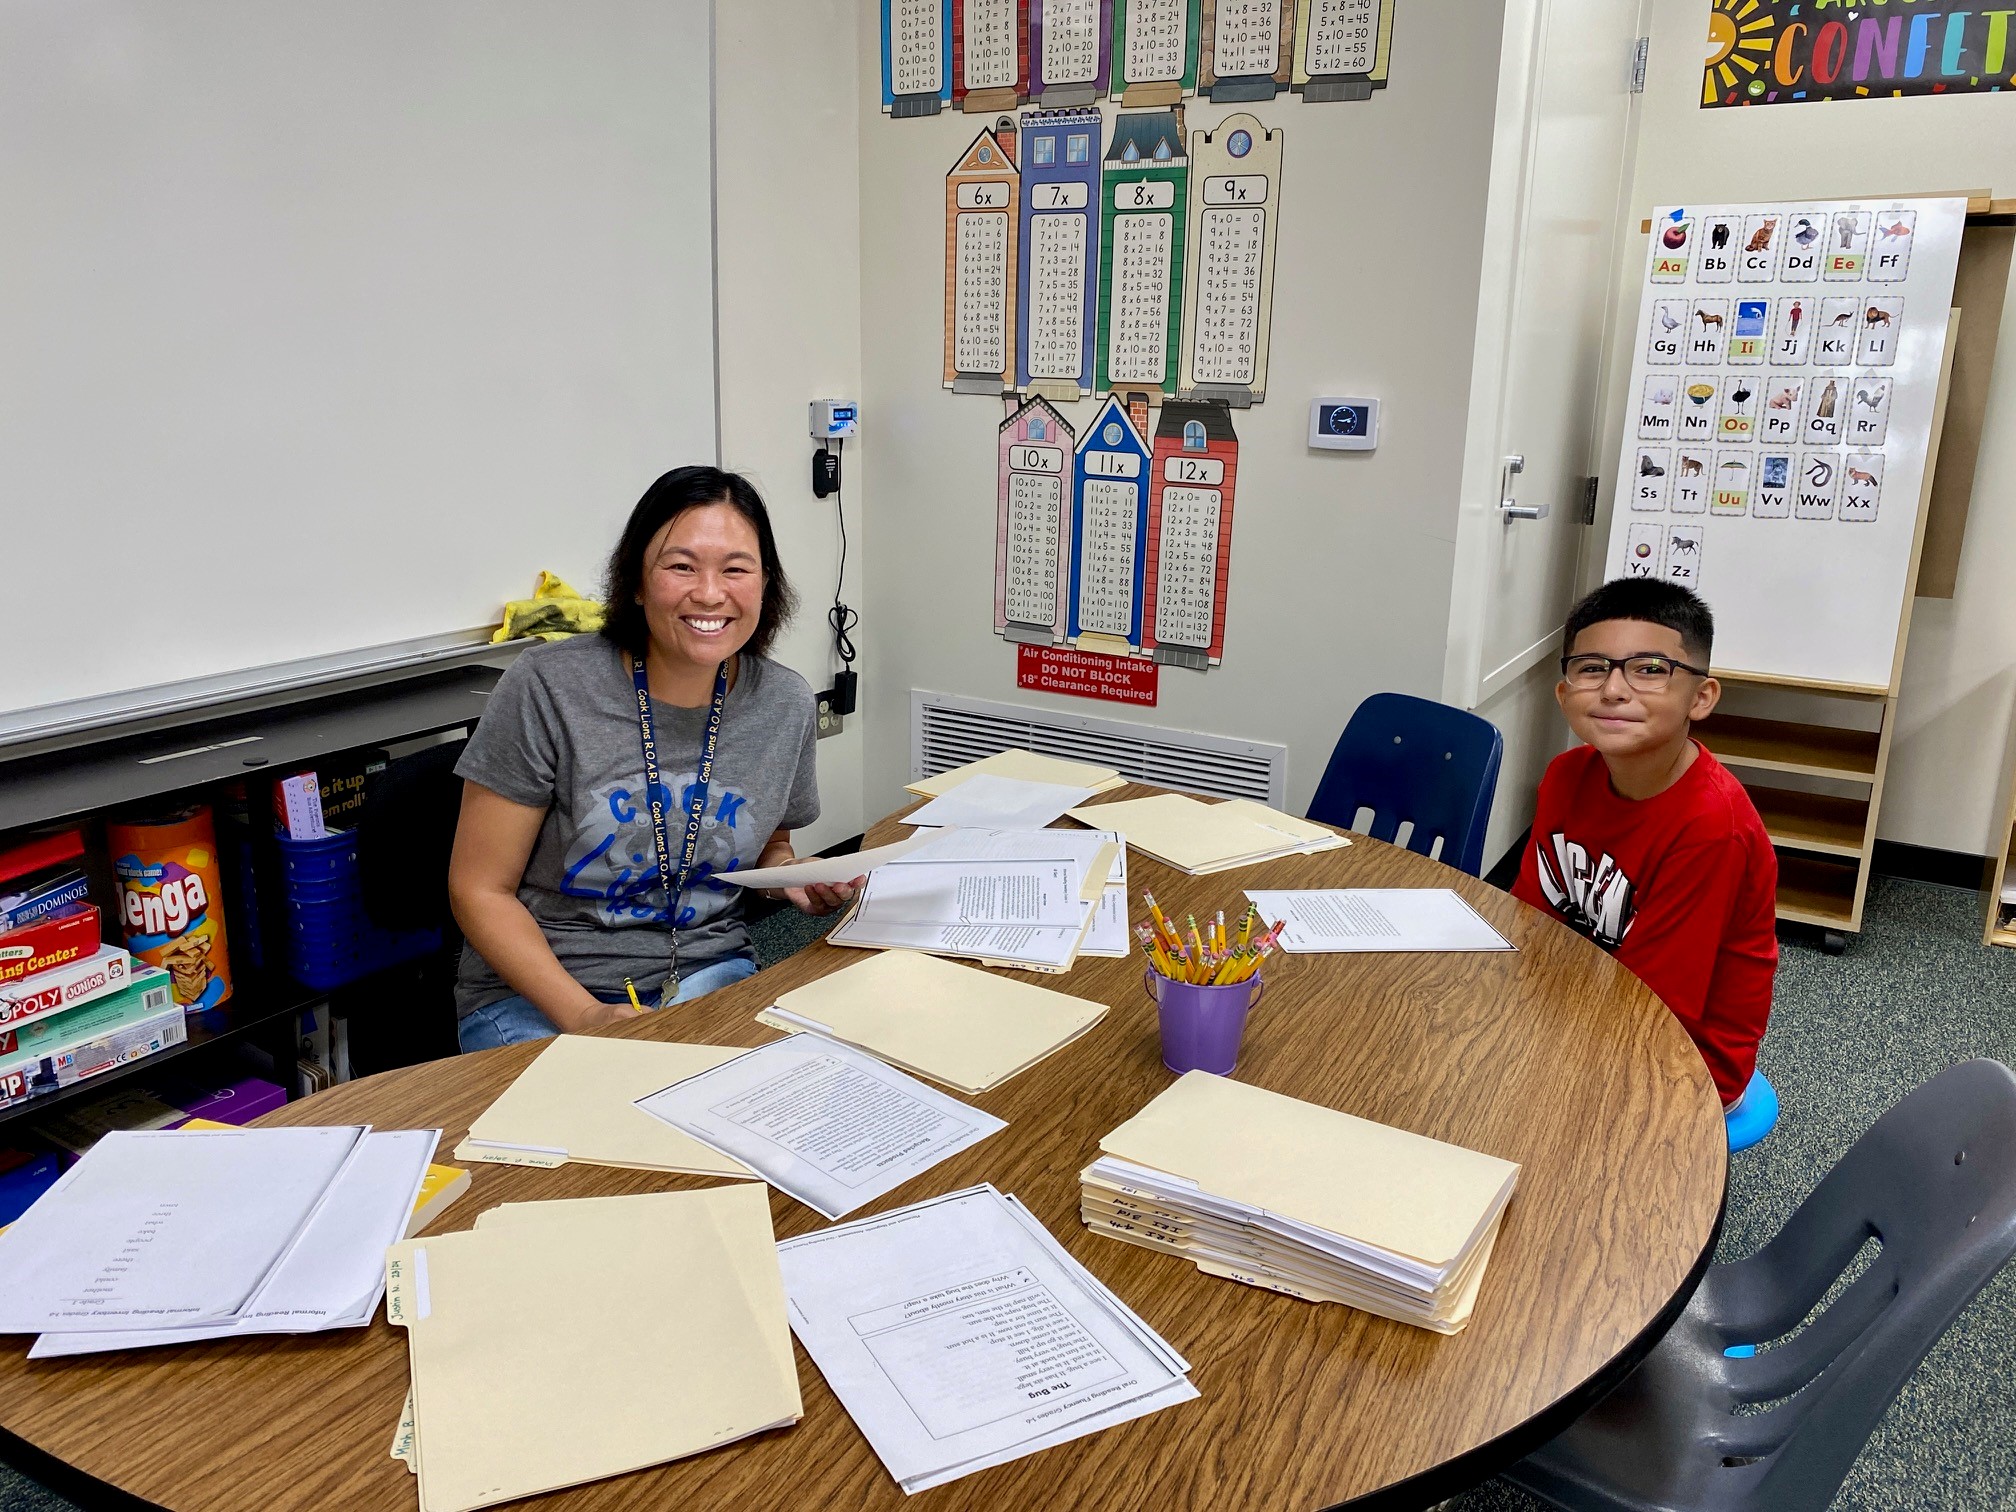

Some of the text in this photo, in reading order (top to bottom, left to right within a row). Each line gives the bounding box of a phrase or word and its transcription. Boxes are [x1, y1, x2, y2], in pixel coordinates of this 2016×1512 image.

[974, 185, 992, 205] 6x
[1050, 186, 1069, 206] 7x
[1133, 185, 1155, 206] 8x
[1224, 180, 1247, 200] 9x
[1247, 240, 1257, 249] 18
[1244, 253, 1256, 263] 27
[1704, 258, 1726, 270] Bb
[1746, 257, 1767, 269] Cc
[1788, 256, 1813, 269] Dd
[1833, 257, 1855, 270] Ee
[1879, 255, 1899, 268] Ff
[1244, 266, 1255, 276] 36
[1658, 260, 1681, 273] Aa
[1242, 279, 1254, 289] 45
[1242, 292, 1253, 302] 54
[1241, 305, 1253, 315] 63
[1241, 318, 1252, 328] 72
[1239, 331, 1250, 340] 81
[1239, 344, 1251, 354] 90
[1654, 340, 1677, 355] Gg
[1693, 340, 1716, 352] Hh
[1740, 341, 1754, 354] Ii
[1781, 339, 1797, 355] Jj
[1822, 340, 1845, 352] Kk
[1869, 340, 1885, 352] Ll
[1238, 357, 1249, 366] 99
[1642, 415, 1670, 428] Mm
[1685, 416, 1708, 428] Nn
[1724, 418, 1749, 432] Oo
[1768, 418, 1791, 434] Pp
[1810, 419, 1837, 435] Qq
[1856, 420, 1877, 433] Rr
[1022, 449, 1049, 469] 10x
[1100, 454, 1124, 474] 11x
[1179, 460, 1208, 481] 12x
[1640, 486, 1658, 499] Ss
[1681, 488, 1698, 501] Tt
[1718, 492, 1740, 505] Uu
[1761, 494, 1784, 506] Vv
[1800, 494, 1831, 507] Ww
[1846, 496, 1871, 509] Xx
[1206, 506, 1215, 515] 12
[1203, 518, 1215, 527] 24
[1202, 529, 1214, 539] 36
[1202, 541, 1212, 550] 48
[1201, 553, 1212, 563] 60
[1630, 563, 1651, 579] Yy
[1671, 565, 1691, 578] Zz
[1023, 648, 1153, 673] Air Conditioning Intake
[1042, 664, 1131, 684] DO NOT BLOCK
[1041, 676, 1098, 692] Clearance
[1101, 684, 1153, 700] Required
[638, 689, 649, 712] Cook
[641, 714, 650, 739] Lions
[704, 735, 716, 759] Lions
[700, 761, 711, 784] Cook
[652, 801, 664, 825] Cook
[655, 826, 665, 852] Lions
[682, 842, 694, 867] Lions
[38, 884, 88, 915] DOMINOES
[115, 873, 207, 935] Jenga
[27, 946, 79, 971] Center
[0, 990, 58, 1023] POLY
[874, 1136, 931, 1167] Recycled Products
[1113, 1199, 1137, 1208] 2nd
[1117, 1210, 1141, 1220] 3rd
[973, 1279, 991, 1287] does
[990, 1274, 1009, 1282] Why
[944, 1287, 961, 1296] bug
[993, 1282, 1016, 1291] What
[928, 1293, 946, 1301] take
[954, 1293, 973, 1302] story
[901, 1299, 922, 1309] nap?
[929, 1299, 955, 1310] mostly
[902, 1306, 931, 1318] about?
[1043, 1373, 1058, 1381] has
[1120, 1379, 1138, 1388] Oral
[1026, 1381, 1071, 1400] The Bug
[1089, 1384, 1121, 1399] Reading
[1061, 1395, 1091, 1409] Fluency
[1036, 1407, 1062, 1419] Grades
